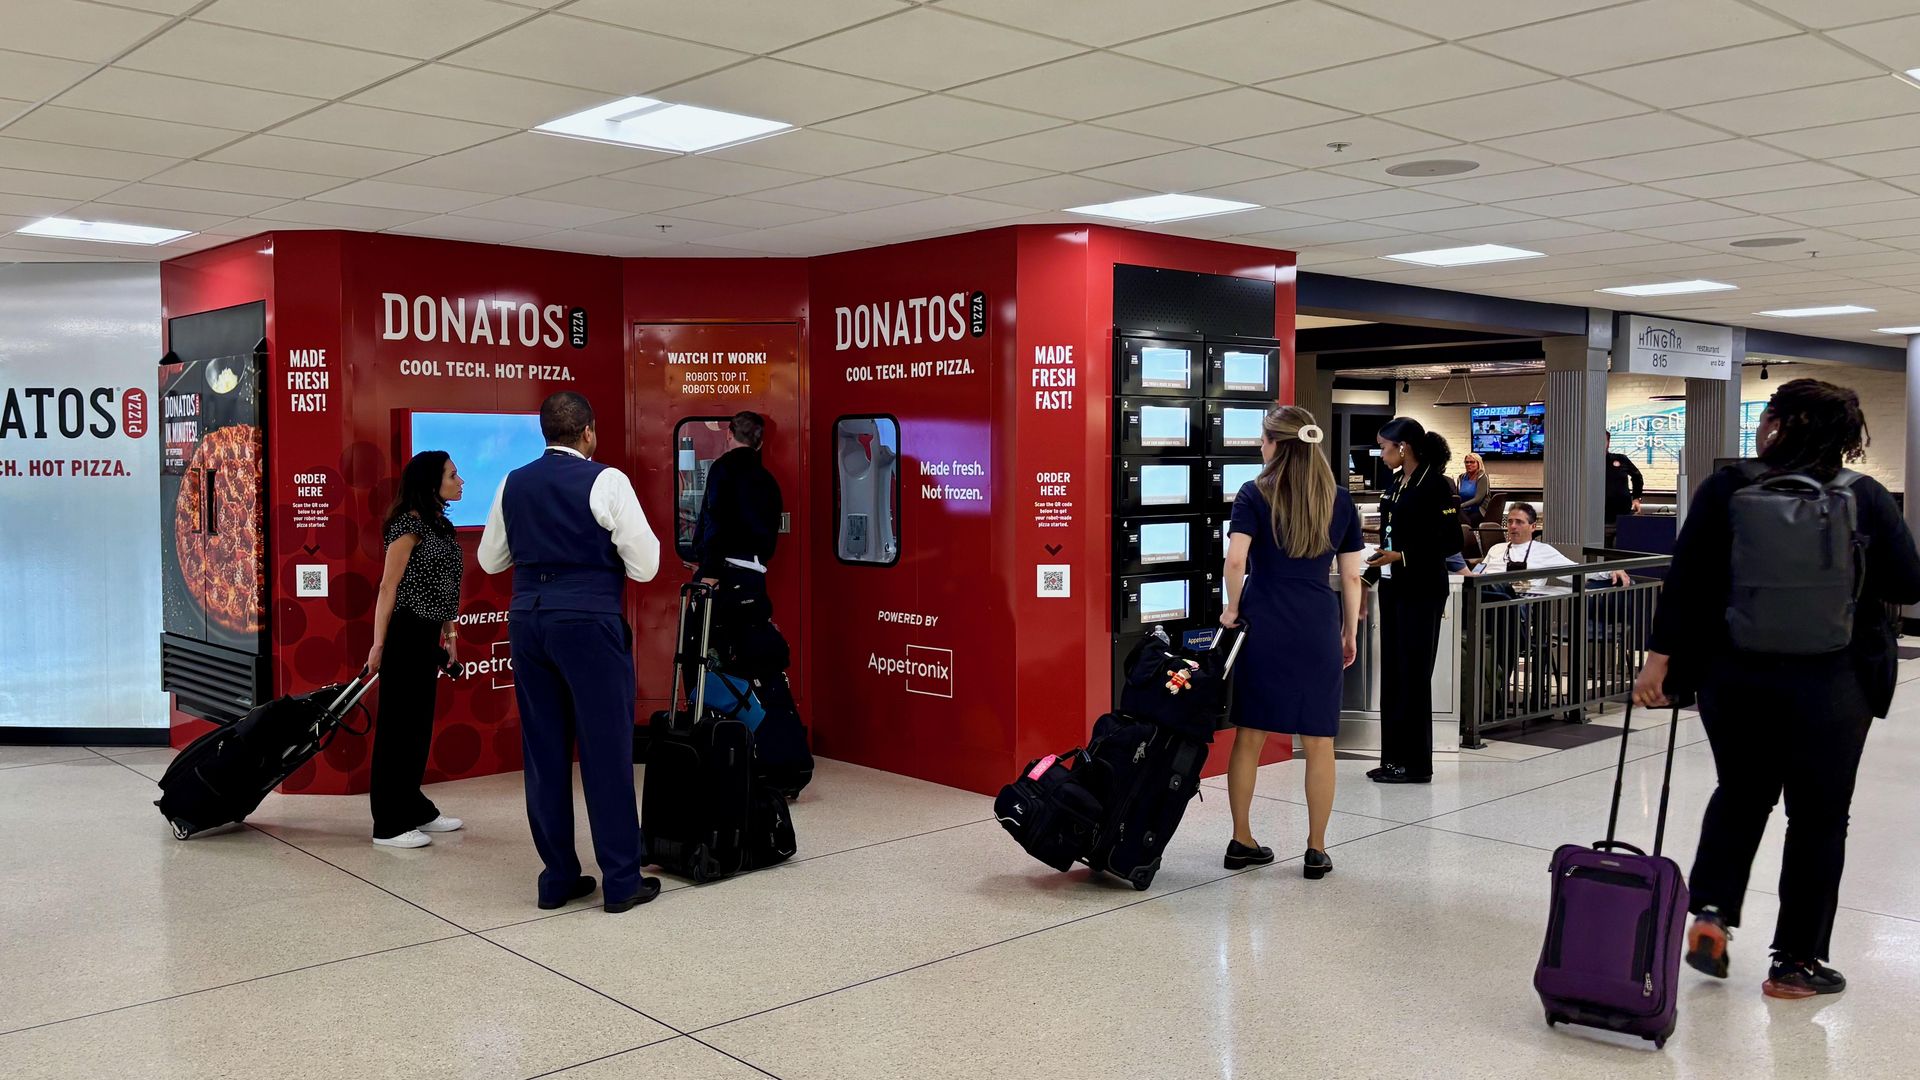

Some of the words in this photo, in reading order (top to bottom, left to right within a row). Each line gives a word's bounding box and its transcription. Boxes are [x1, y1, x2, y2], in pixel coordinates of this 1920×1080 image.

[382, 293, 565, 348] DONATOS
[835, 292, 966, 351] DONATOS
[973, 295, 983, 333] PIZZA
[573, 312, 584, 345] PIZZA
[290, 349, 326, 367] MADE
[668, 352, 708, 364] WATCH
[712, 352, 724, 364] IT
[728, 352, 767, 364] WORK!
[1035, 345, 1073, 364] MADE
[1652, 353, 1667, 368] 815
[400, 359, 441, 376] COOL
[446, 361, 490, 378] TECH.
[495, 363, 524, 379] HOT
[529, 365, 575, 381] PIZZA.
[685, 372, 718, 381] ROBOTS
[720, 372, 737, 381] TOP
[739, 372, 749, 381] IT.
[846, 366, 873, 382] COOL
[875, 363, 907, 380] TECH.
[911, 361, 933, 378] HOT
[936, 358, 975, 376] PIZZA.
[1032, 367, 1076, 387] FRESH
[288, 371, 329, 389] FRESH
[682, 384, 715, 394] ROBOTS
[717, 384, 740, 394] COOK
[742, 384, 752, 394] IT.
[165, 394, 196, 417] DONATOS
[291, 393, 327, 411] FAST!
[1036, 391, 1072, 409] FAST!
[0, 388, 116, 439] ATOS
[128, 393, 142, 433] PIZZA
[1609, 411, 1685, 431] HANGA
[1636, 436, 1664, 448] 815
[29, 460, 65, 476] HOT
[71, 460, 131, 476] PIZZA.
[920, 461, 949, 475] Made
[952, 460, 985, 475] fresh.
[294, 473, 327, 484] ORDER
[1036, 472, 1070, 483] ORDER
[298, 486, 323, 497] HERE
[922, 484, 942, 499] Not
[944, 484, 983, 500] frozen.
[1040, 485, 1067, 496] HERE
[878, 610, 923, 625] POWERED
[925, 615, 938, 627] BY
[868, 652, 949, 680] Appetronix
